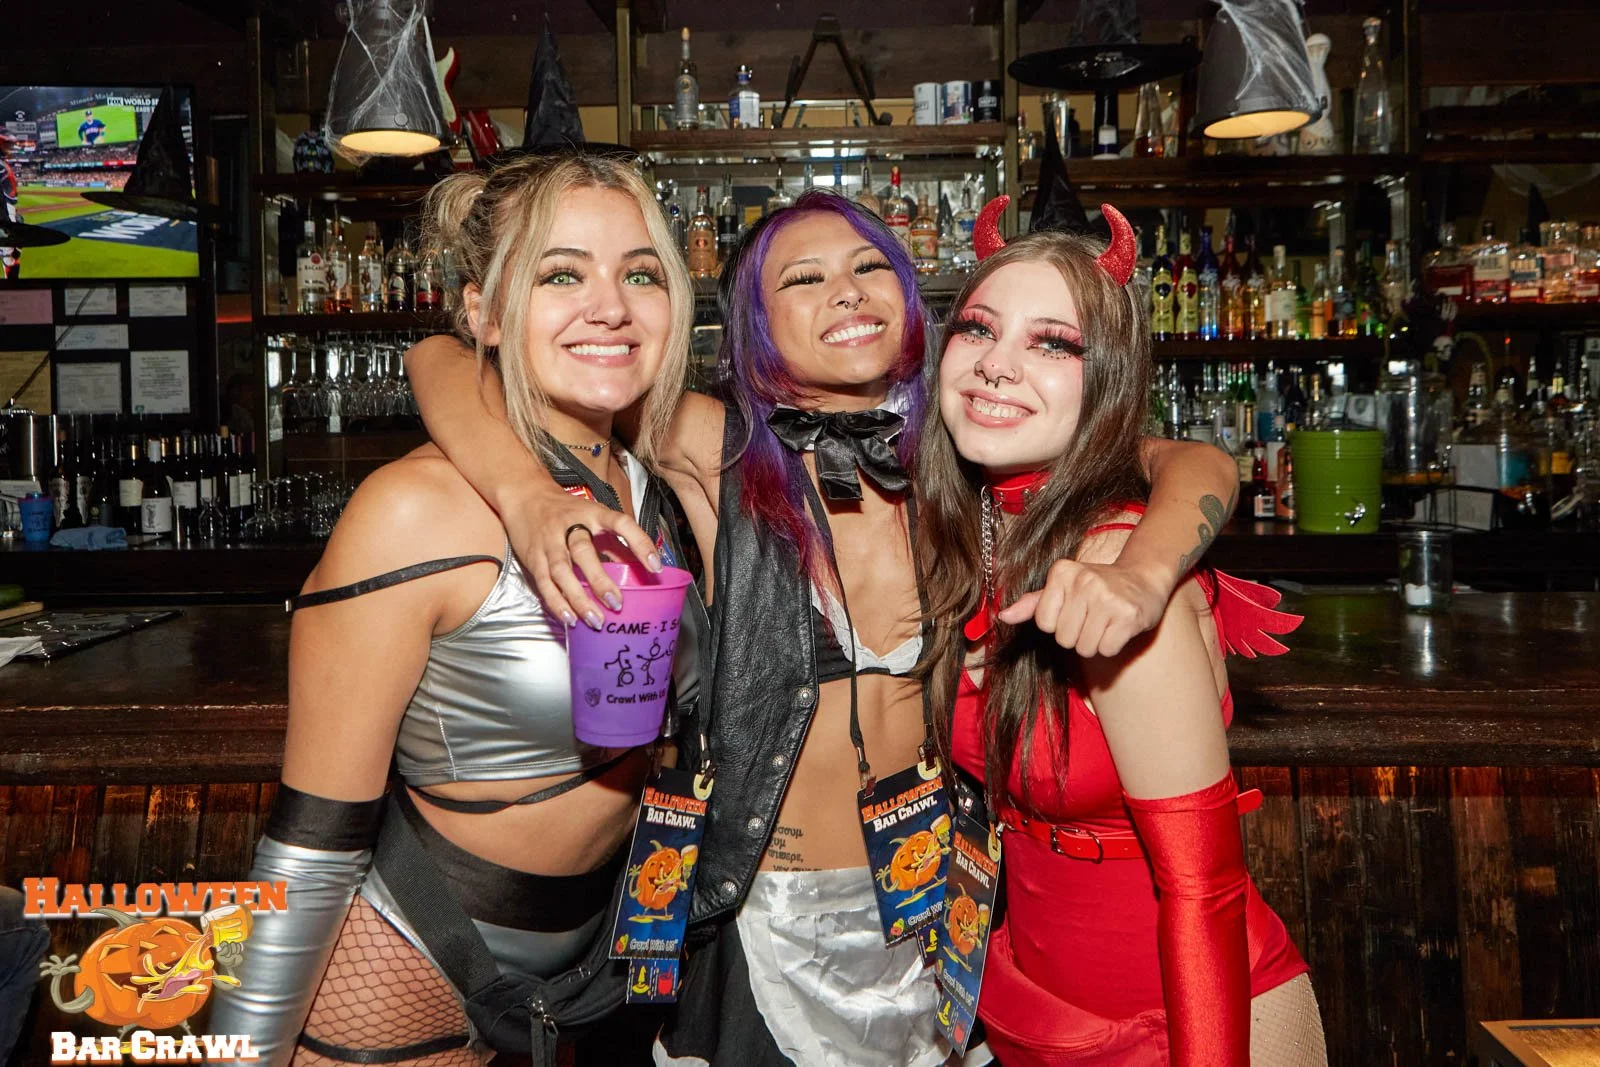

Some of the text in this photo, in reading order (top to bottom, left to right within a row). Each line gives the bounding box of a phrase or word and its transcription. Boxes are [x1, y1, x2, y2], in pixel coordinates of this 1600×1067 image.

[124, 98, 151, 106] WORLD
[606, 622, 651, 635] CAME
[606, 693, 636, 704] Crawl
[639, 691, 658, 703] With
[643, 786, 707, 816] HALLOWEEN
[861, 777, 943, 823] HALLOWEEN
[873, 795, 938, 832] BAR CRAWL
[646, 807, 697, 830] BAR CRAWL
[953, 830, 998, 879] HALLOWEEN
[956, 850, 990, 889] BAR CRAWL
